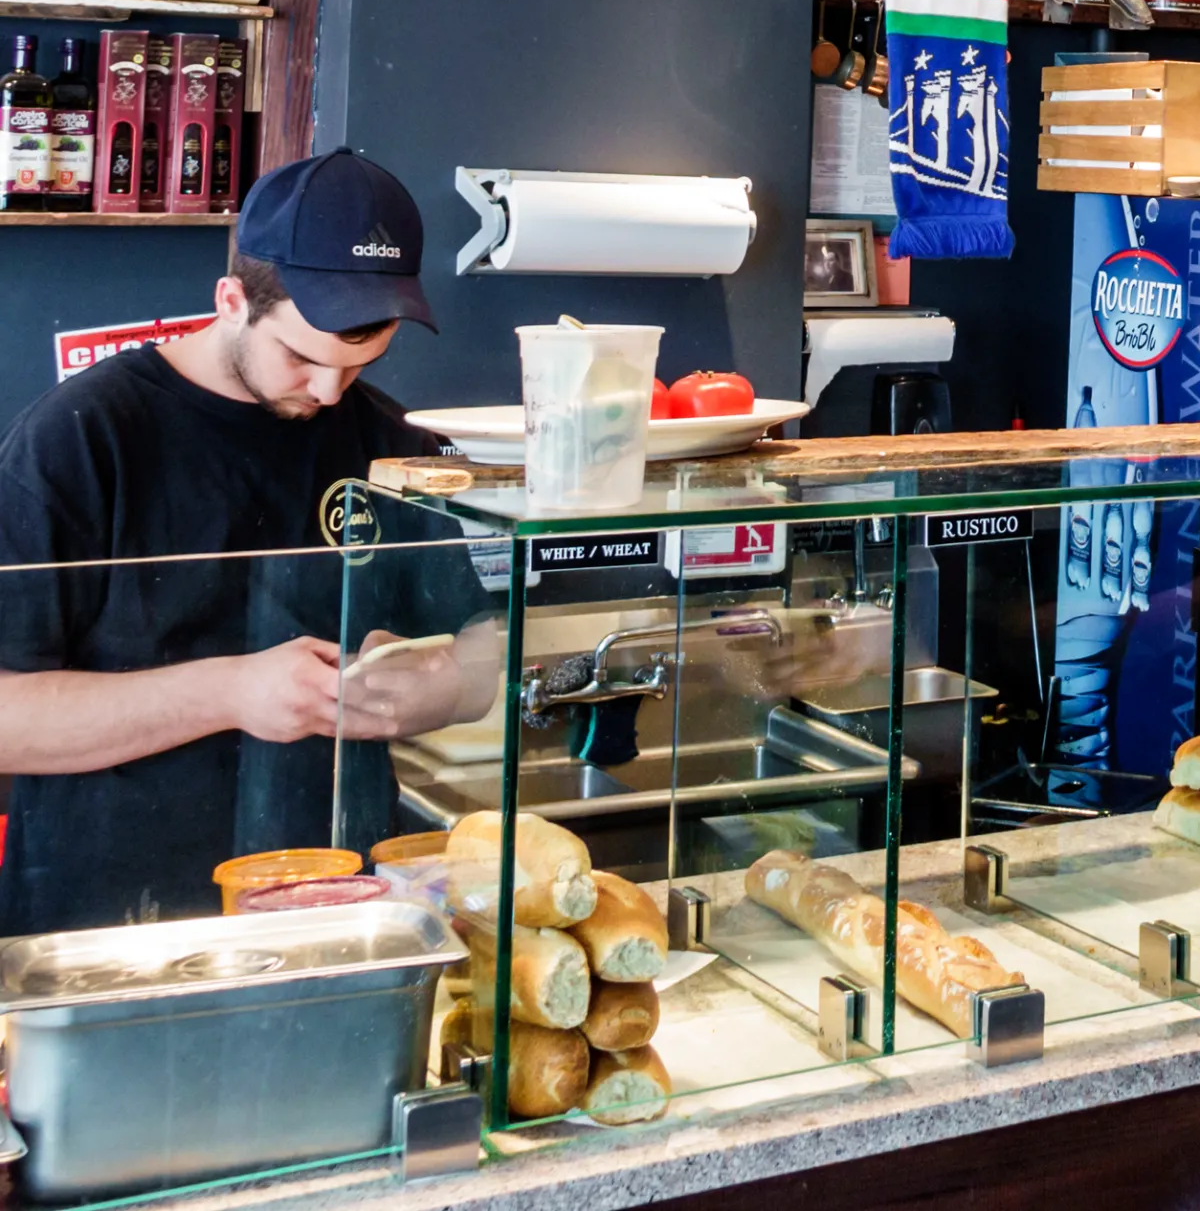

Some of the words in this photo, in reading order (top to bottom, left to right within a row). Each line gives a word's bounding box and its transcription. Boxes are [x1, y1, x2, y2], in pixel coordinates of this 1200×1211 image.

[352, 242, 401, 259] adidas
[1094, 270, 1183, 320] ROCCHETTA
[105, 327, 156, 341] Emergency
[157, 325, 178, 334] Care
[1114, 320, 1157, 351] BrioBlu
[942, 516, 1019, 540] RUSTICO
[539, 545, 585, 561] WHITE
[601, 542, 651, 558] WHEAT
